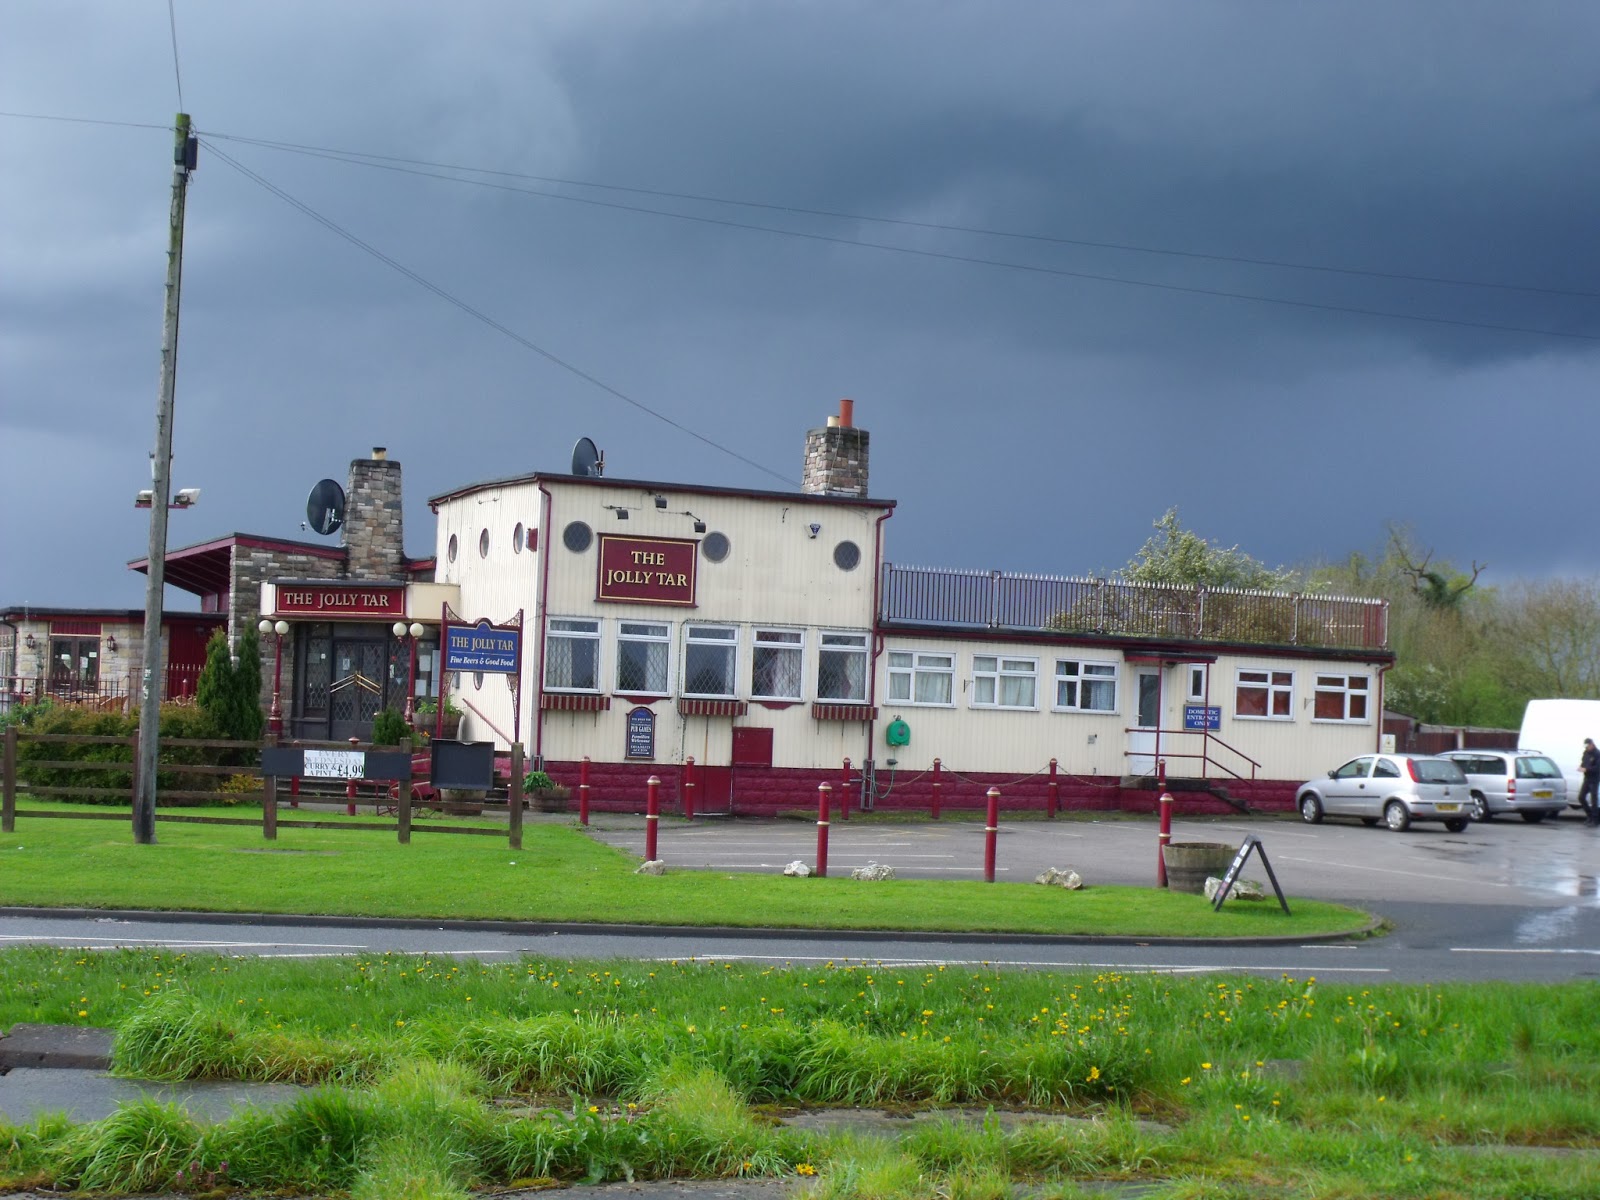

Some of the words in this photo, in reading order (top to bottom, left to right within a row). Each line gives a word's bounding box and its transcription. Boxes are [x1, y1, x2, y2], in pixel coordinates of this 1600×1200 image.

[631, 550, 665, 566] THE
[605, 569, 654, 586] JOLLY
[656, 572, 688, 587] TAR
[284, 592, 313, 605] THE
[318, 593, 359, 609] JOLLY
[361, 594, 389, 607] TAR
[451, 636, 469, 648] THE
[471, 637, 495, 651] JOLLY
[497, 639, 514, 651] TAR
[450, 655, 462, 664] Fine
[463, 656, 479, 665] Beers
[480, 657, 485, 665] &
[485, 658, 500, 666] Good
[500, 658, 514, 667] Food
[337, 764, 364, 778] £4.99
